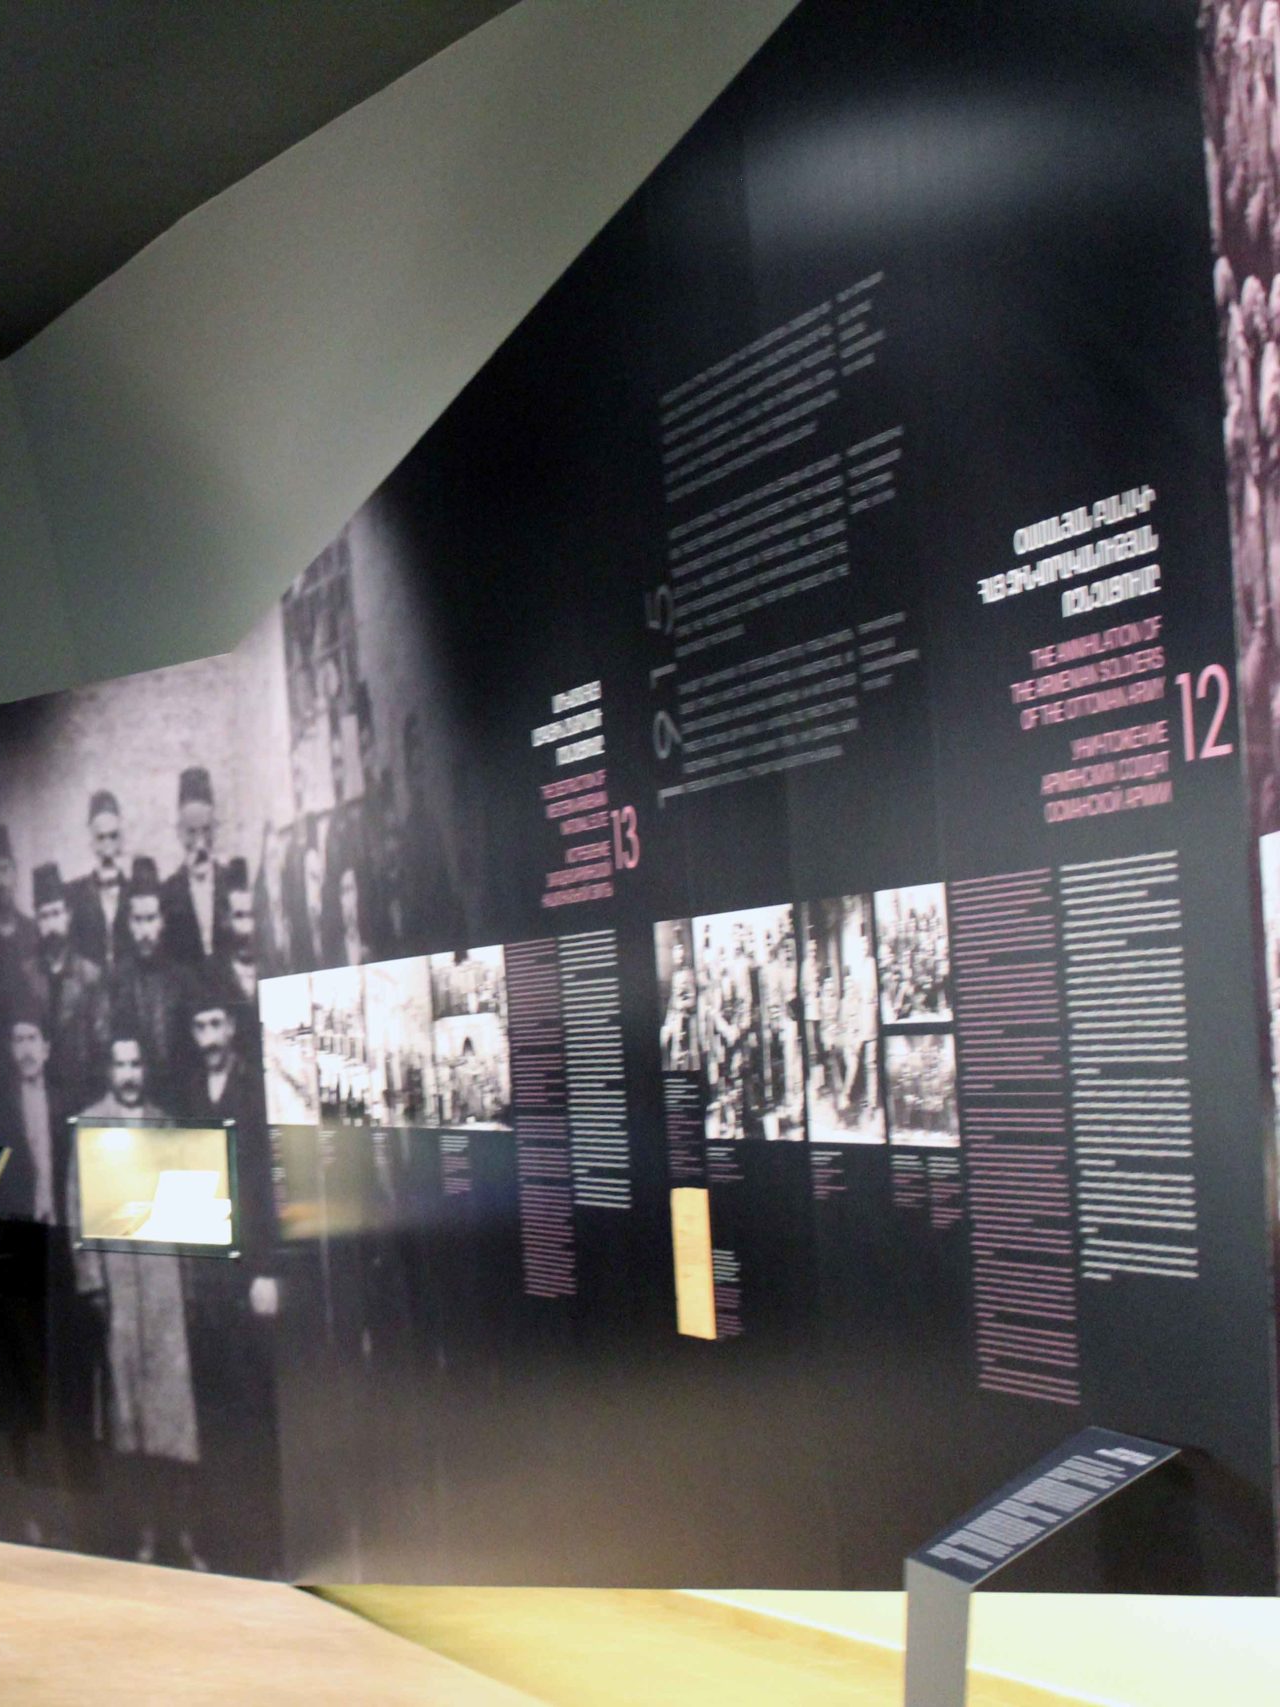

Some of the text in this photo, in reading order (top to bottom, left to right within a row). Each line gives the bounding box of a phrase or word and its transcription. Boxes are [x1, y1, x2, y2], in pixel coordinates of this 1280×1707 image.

[1030, 645, 1057, 669] THE
[644, 585, 686, 808] 1915
[1010, 679, 1036, 703] THE
[1175, 664, 1234, 762] 12
[1020, 706, 1040, 730] OF
[1038, 700, 1065, 725] THE
[610, 805, 641, 870] 13
